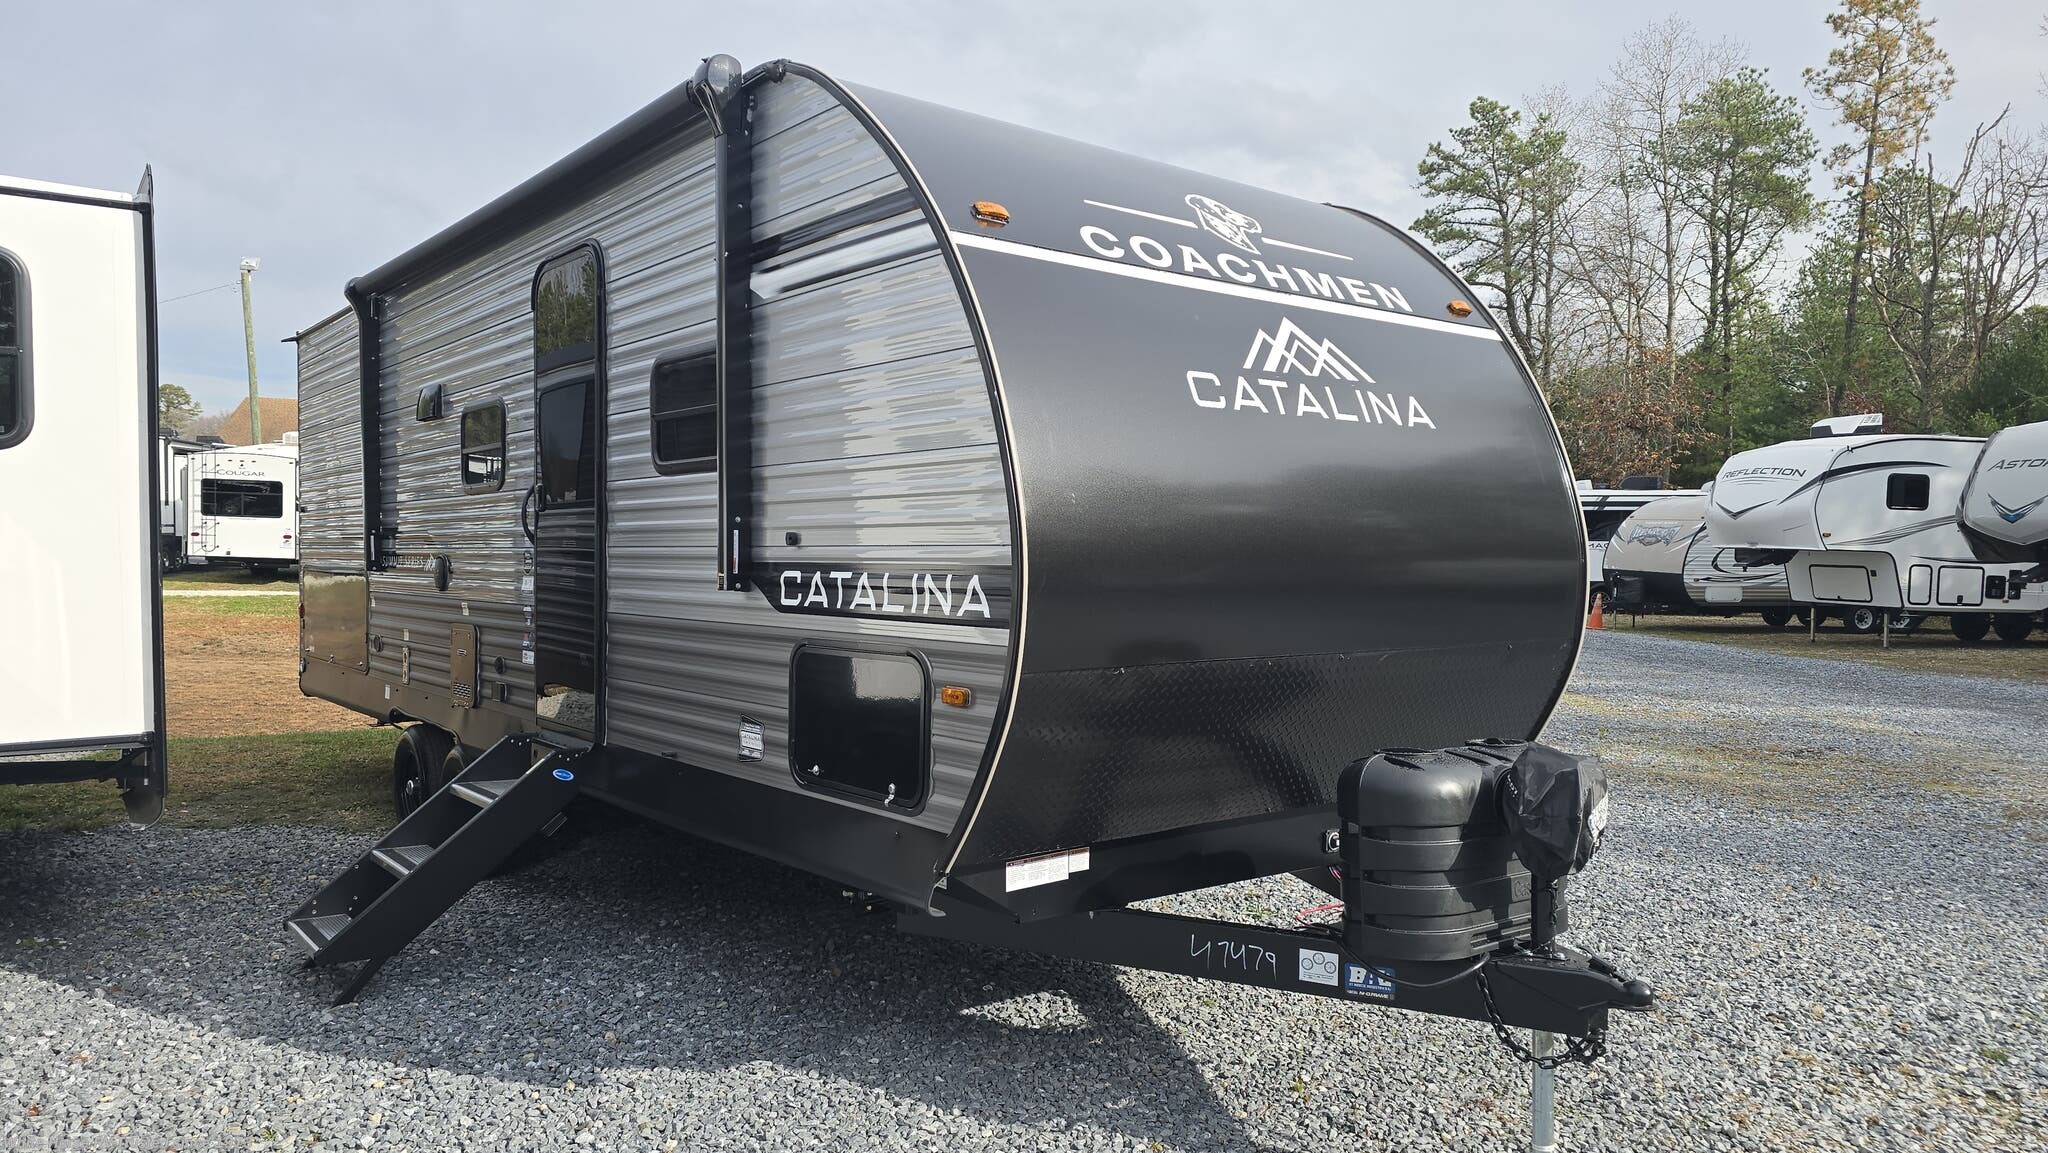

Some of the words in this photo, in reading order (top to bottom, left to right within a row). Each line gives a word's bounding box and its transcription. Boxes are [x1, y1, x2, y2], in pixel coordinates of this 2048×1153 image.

[1080, 225, 1413, 312] COACHMEN
[1187, 370, 1436, 429] CATALINA
[1722, 467, 1807, 480] REFLECTION
[780, 570, 991, 618] CATALINA
[1191, 934, 1277, 980] 47479
